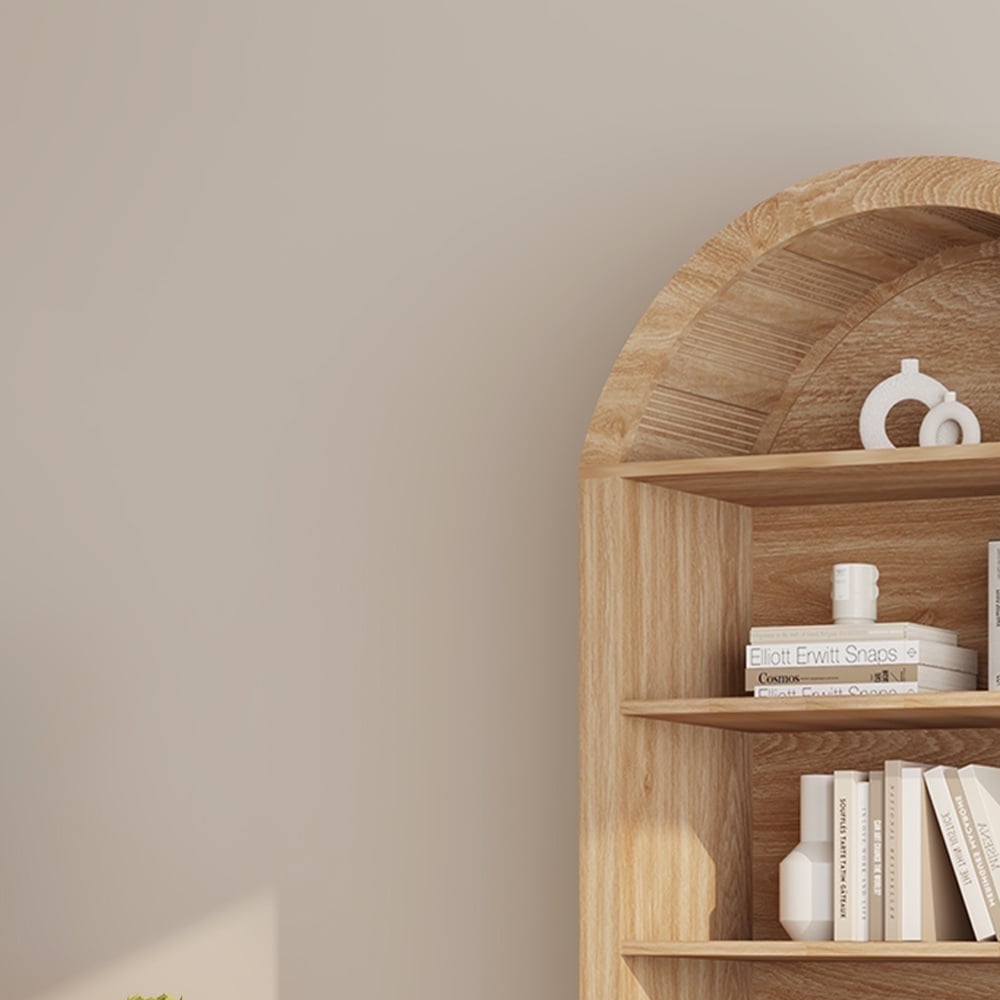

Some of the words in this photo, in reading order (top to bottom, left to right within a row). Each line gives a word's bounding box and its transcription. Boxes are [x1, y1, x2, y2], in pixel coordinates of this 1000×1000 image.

[750, 646, 792, 667] Elliott
[796, 645, 840, 666] Erwitt
[845, 643, 898, 665] Snaps
[758, 672, 801, 685] Cosmos
